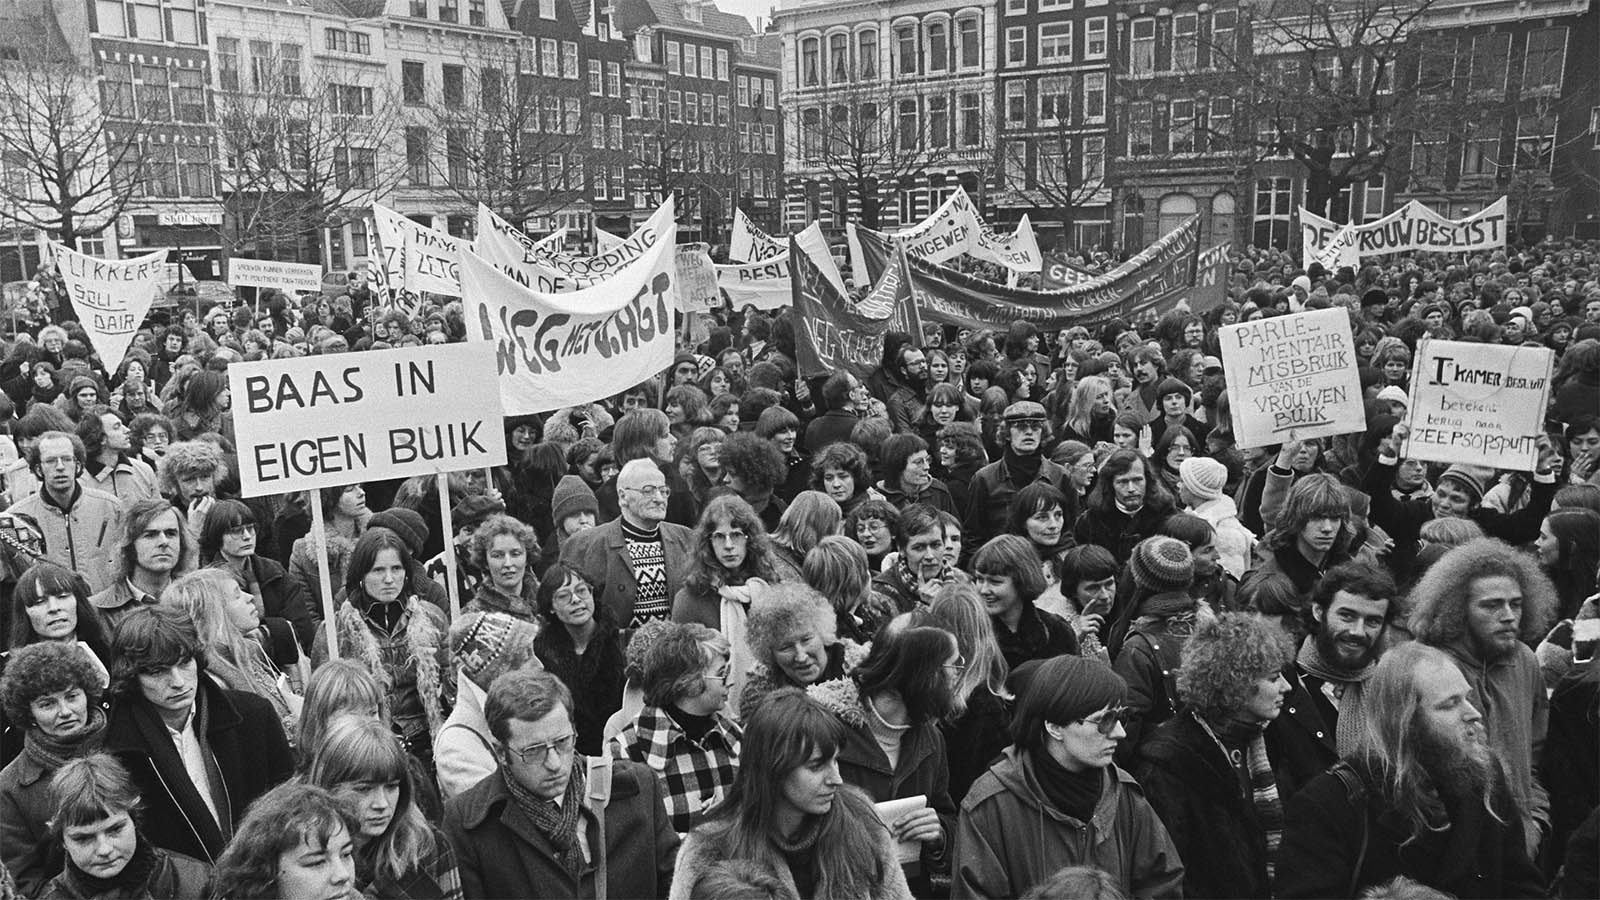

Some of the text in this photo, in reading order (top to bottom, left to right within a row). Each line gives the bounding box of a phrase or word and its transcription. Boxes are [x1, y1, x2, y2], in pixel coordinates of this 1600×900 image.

[1356, 218, 1414, 250] ROUW
[1416, 214, 1504, 247] BESLIST
[56, 248, 160, 281] FLIKKERS
[94, 314, 134, 330] DAIR
[1236, 317, 1320, 348] PARLE-
[479, 303, 570, 376] WEG
[561, 320, 602, 357] MET
[1261, 332, 1345, 362] MENTAIR
[1248, 351, 1349, 384] MISBRUIK
[1454, 364, 1502, 387] KAMER
[1505, 376, 1545, 390] BESLUIT
[246, 360, 435, 414] BAAS IN
[1255, 385, 1347, 413] VROUWEN
[1269, 376, 1313, 393] VAN DE
[1274, 406, 1327, 428] BUIK
[254, 420, 487, 482] EIGEN BUIK
